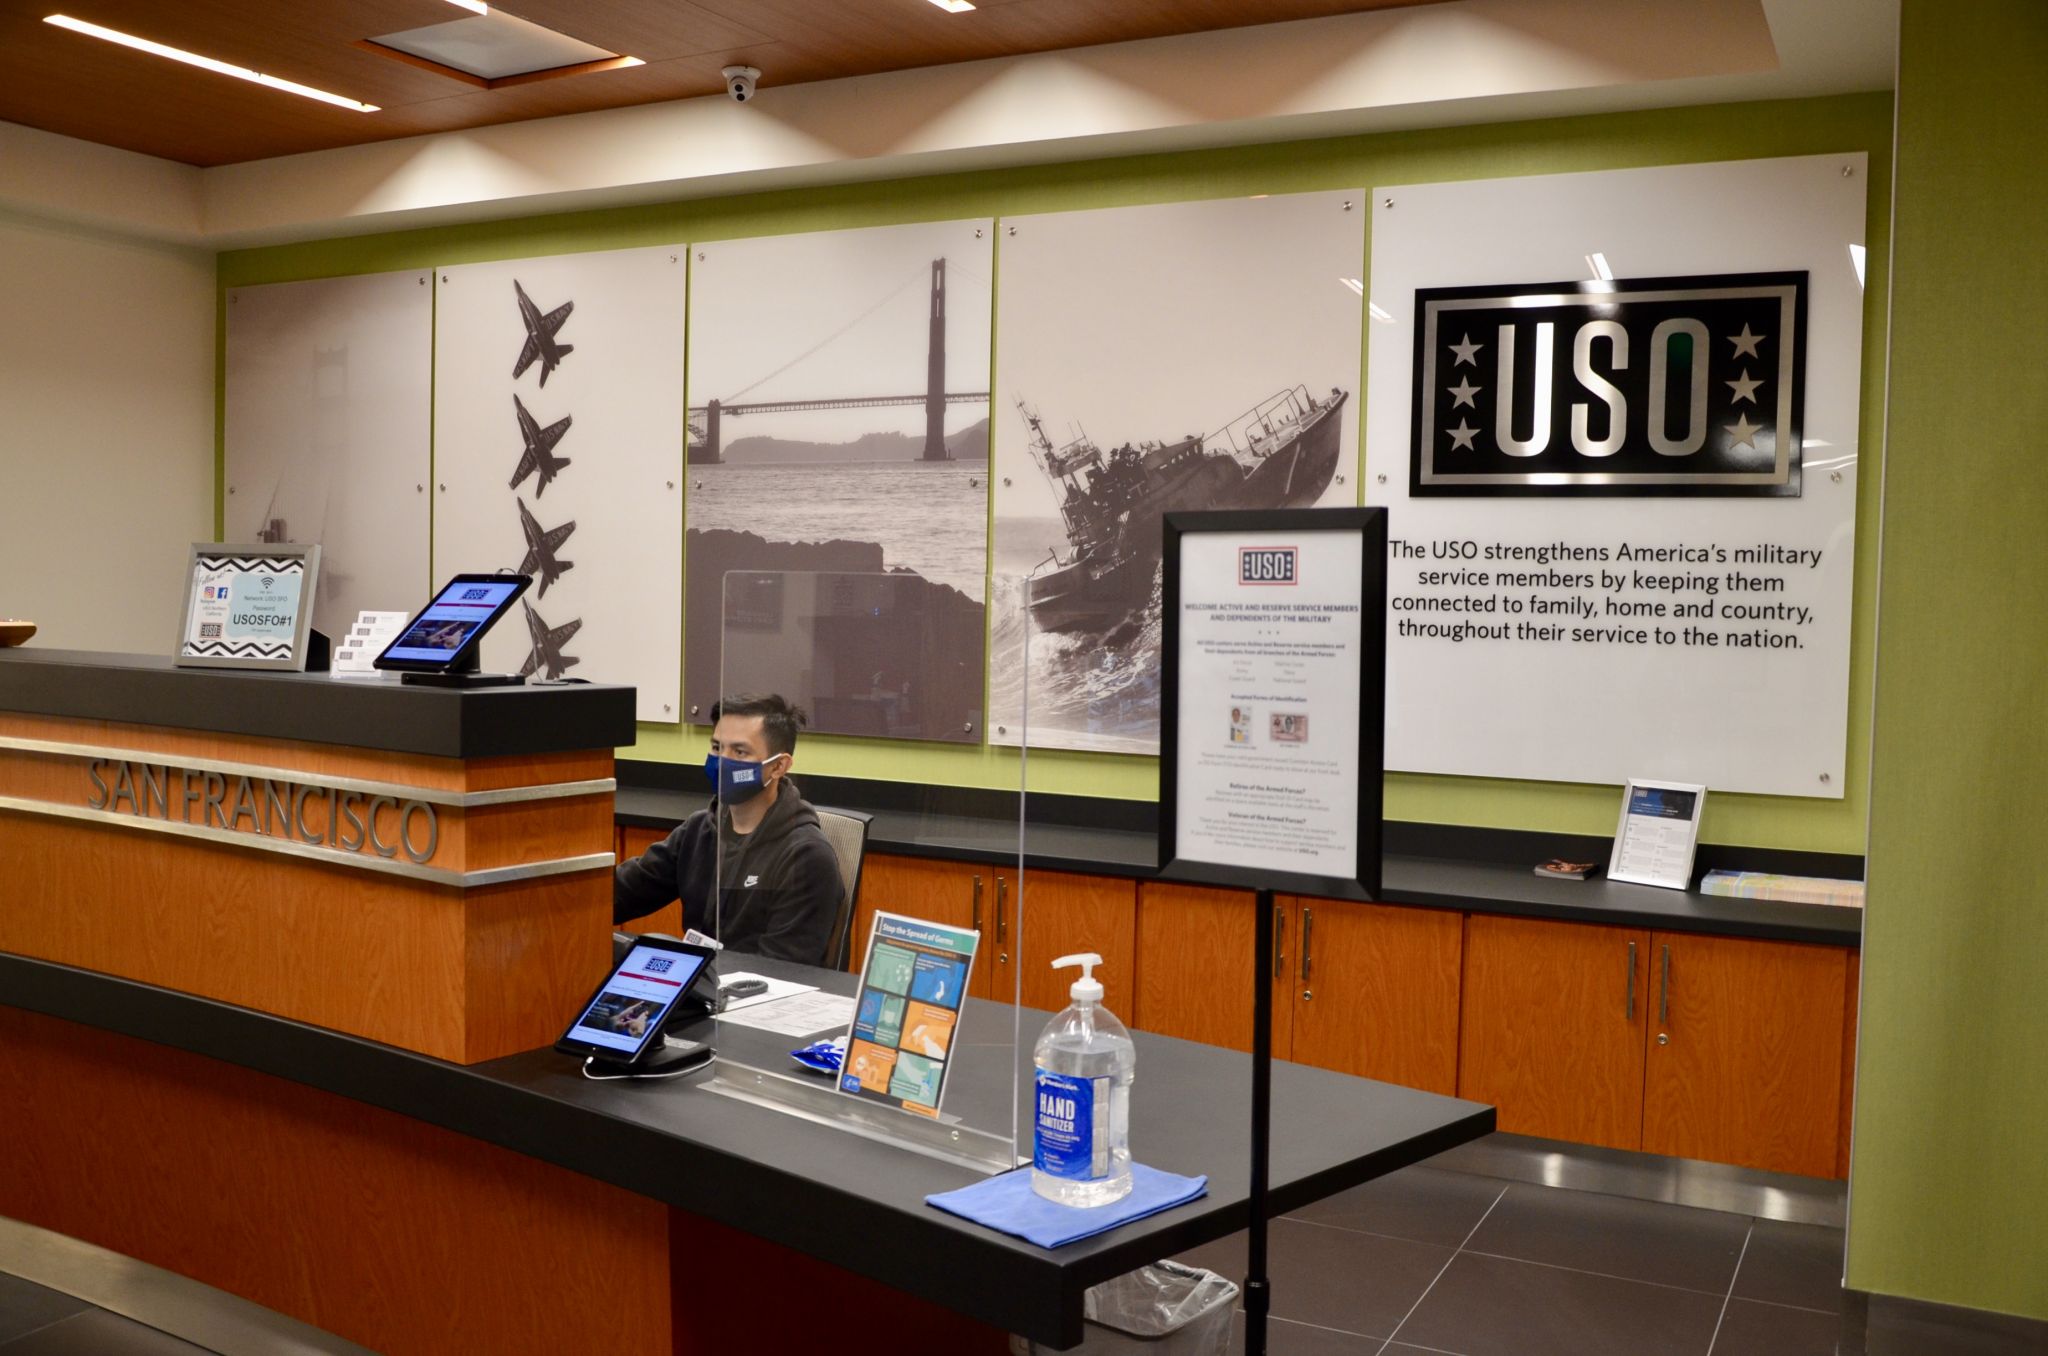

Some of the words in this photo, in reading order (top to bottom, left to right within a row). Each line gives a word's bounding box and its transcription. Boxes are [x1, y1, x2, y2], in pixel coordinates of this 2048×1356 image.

[1495, 317, 1711, 457] USO
[1251, 552, 1285, 579] USO
[1389, 540, 1426, 559] The
[1432, 540, 1478, 560] USO
[1484, 541, 1609, 565] strengthens
[1616, 542, 1727, 563] America's
[1734, 543, 1822, 568] military
[1418, 567, 1489, 586] service
[1496, 568, 1594, 588] members
[1601, 569, 1626, 592] by
[1633, 569, 1720, 595] keeping
[1726, 571, 1784, 592] them
[233, 614, 292, 627] USOSFO#1
[1185, 603, 1217, 611] WELCOME
[1245, 604, 1260, 612] AND
[1262, 604, 1291, 612] RESERVE
[1293, 604, 1321, 612] SERVICE
[1323, 604, 1359, 613] MEMBERS
[1210, 614, 1226, 622] AND
[1226, 614, 1271, 622] DEPENDENTS
[1298, 615, 1332, 623] MILITARY
[1391, 593, 1496, 612] connected
[1503, 595, 1523, 613] to
[1529, 595, 1598, 619] family,
[1605, 596, 1667, 617] home
[1673, 598, 1714, 618] and
[1721, 601, 1814, 625] country,
[1398, 618, 1511, 642] throughout
[1517, 621, 1566, 641] their
[1571, 624, 1648, 644] service
[1654, 626, 1676, 645] to
[1683, 626, 1719, 646] the
[1726, 629, 1804, 649] nation.
[88, 757, 169, 821] SAN
[183, 767, 438, 864] FRANCISCO
[882, 923, 896, 935] Stop
[896, 926, 906, 935] the
[906, 929, 928, 939] Spread
[1039, 1092, 1075, 1120] HAND
[1039, 1113, 1075, 1133] SANITIZER
